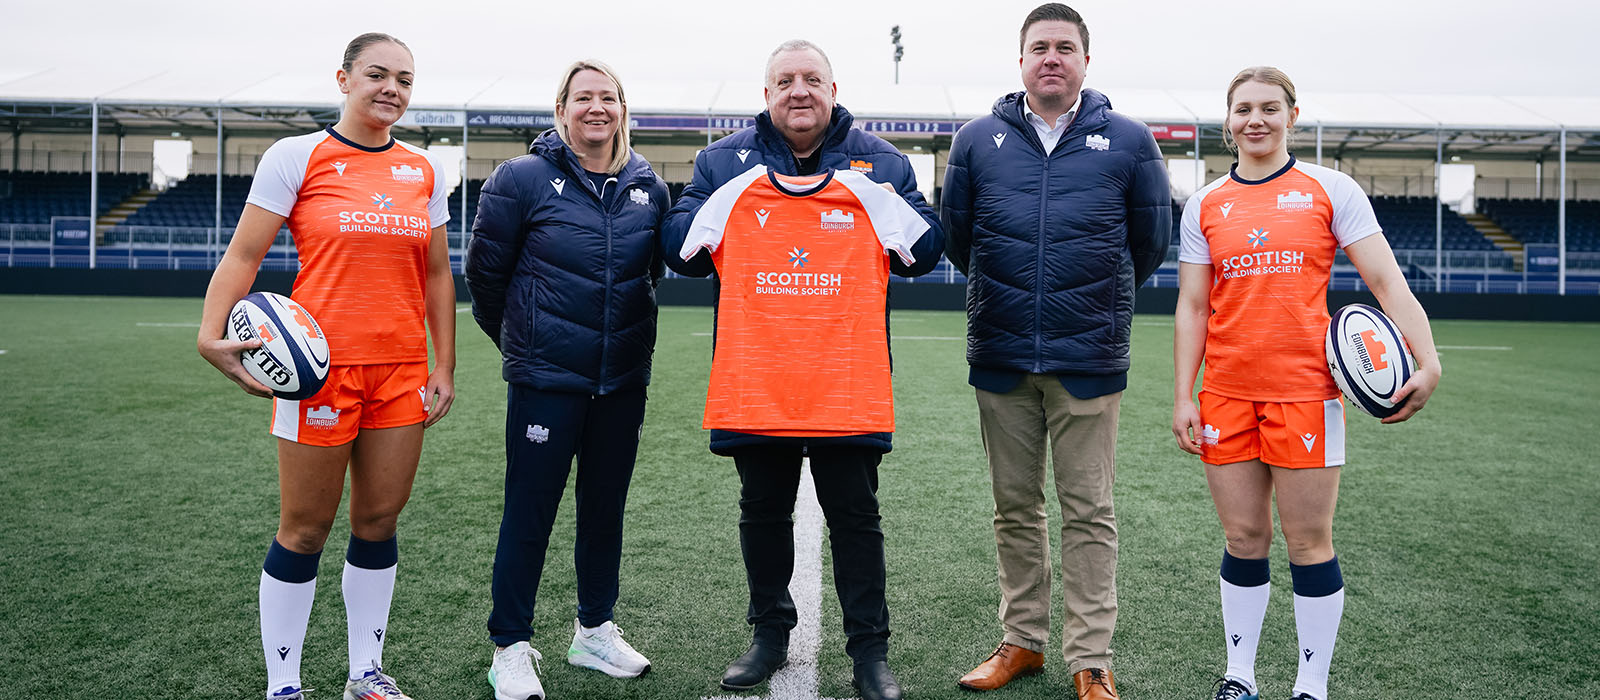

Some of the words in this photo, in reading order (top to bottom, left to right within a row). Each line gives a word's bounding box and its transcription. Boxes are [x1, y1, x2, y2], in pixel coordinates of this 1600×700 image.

[415, 112, 455, 124] Galbraith
[489, 115, 534, 125] BREADALBANE
[715, 119, 748, 128] HOME
[871, 122, 896, 132] EST
[338, 211, 428, 231] SCOTTISH
[820, 222, 855, 230] EDINBURGH
[340, 224, 388, 234] BUILDING
[391, 227, 428, 239] SOCIETY
[1222, 250, 1304, 271] SCOTTISH
[755, 271, 841, 286] SCOTTISH
[1223, 267, 1261, 279] BUILDING
[1262, 265, 1302, 274] SOCIETY
[755, 286, 799, 295] BUILDING
[801, 287, 841, 295] SOCIETY
[1351, 332, 1375, 374] EDINBURGH
